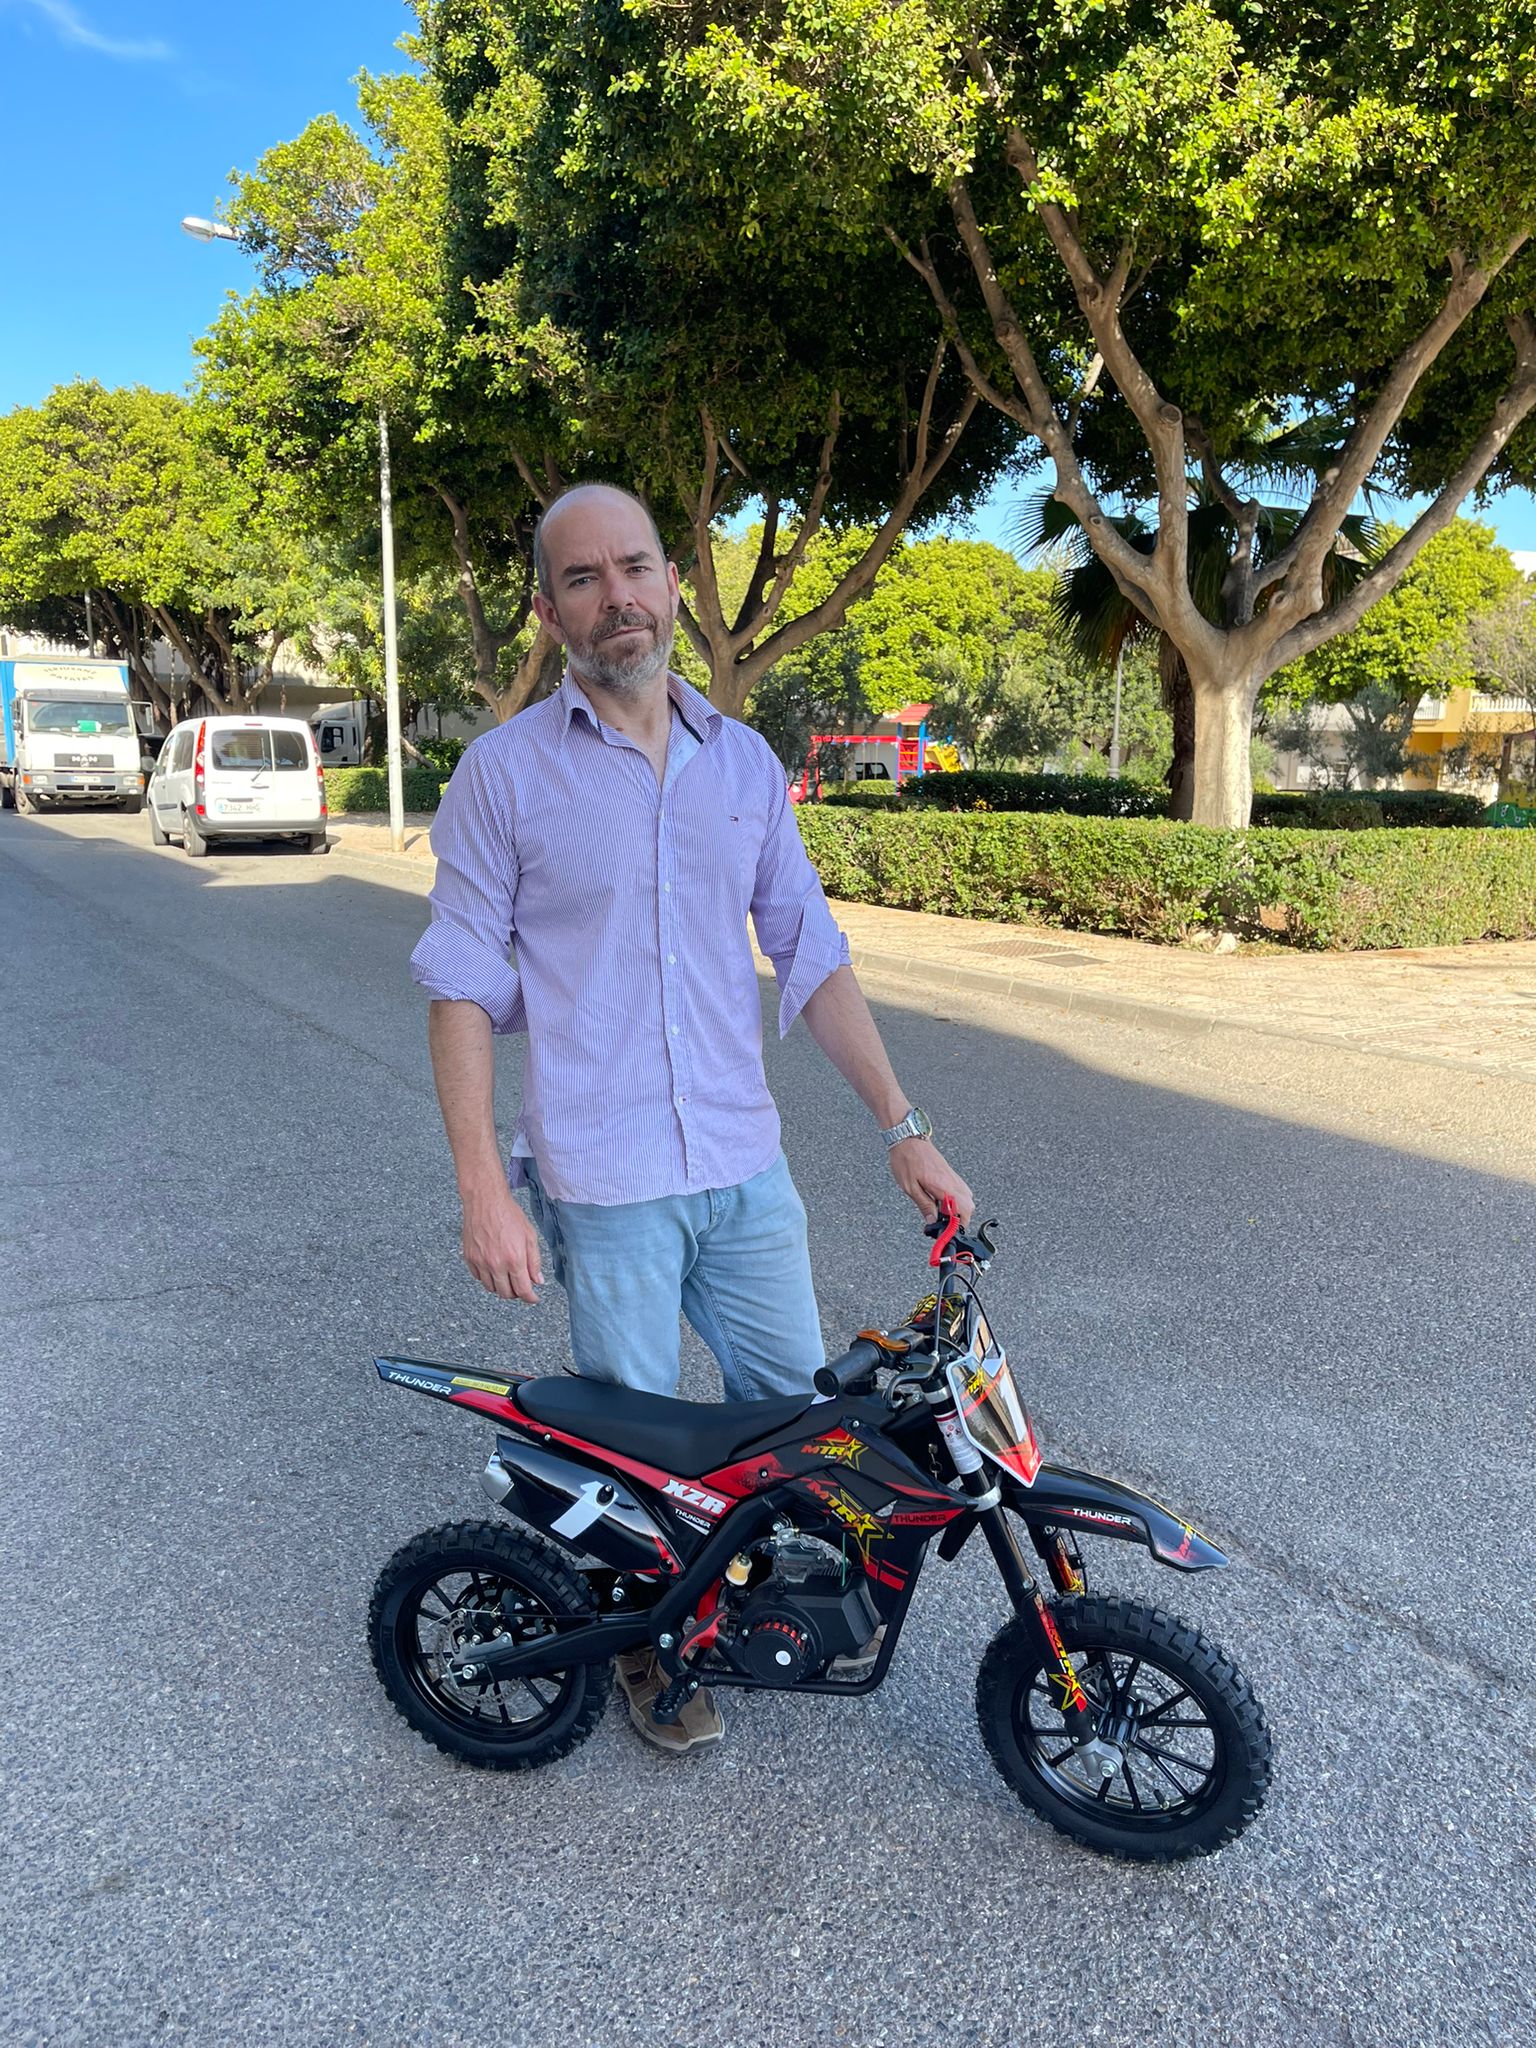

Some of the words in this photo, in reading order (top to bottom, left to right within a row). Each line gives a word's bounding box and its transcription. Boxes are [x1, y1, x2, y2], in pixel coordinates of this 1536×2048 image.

[388, 1371, 452, 1396] THUNDER
[661, 1479, 727, 1515] XZR
[674, 1507, 711, 1528] THUNDER
[894, 1513, 946, 1522] THUNDER
[1072, 1508, 1132, 1526] THUNDER
